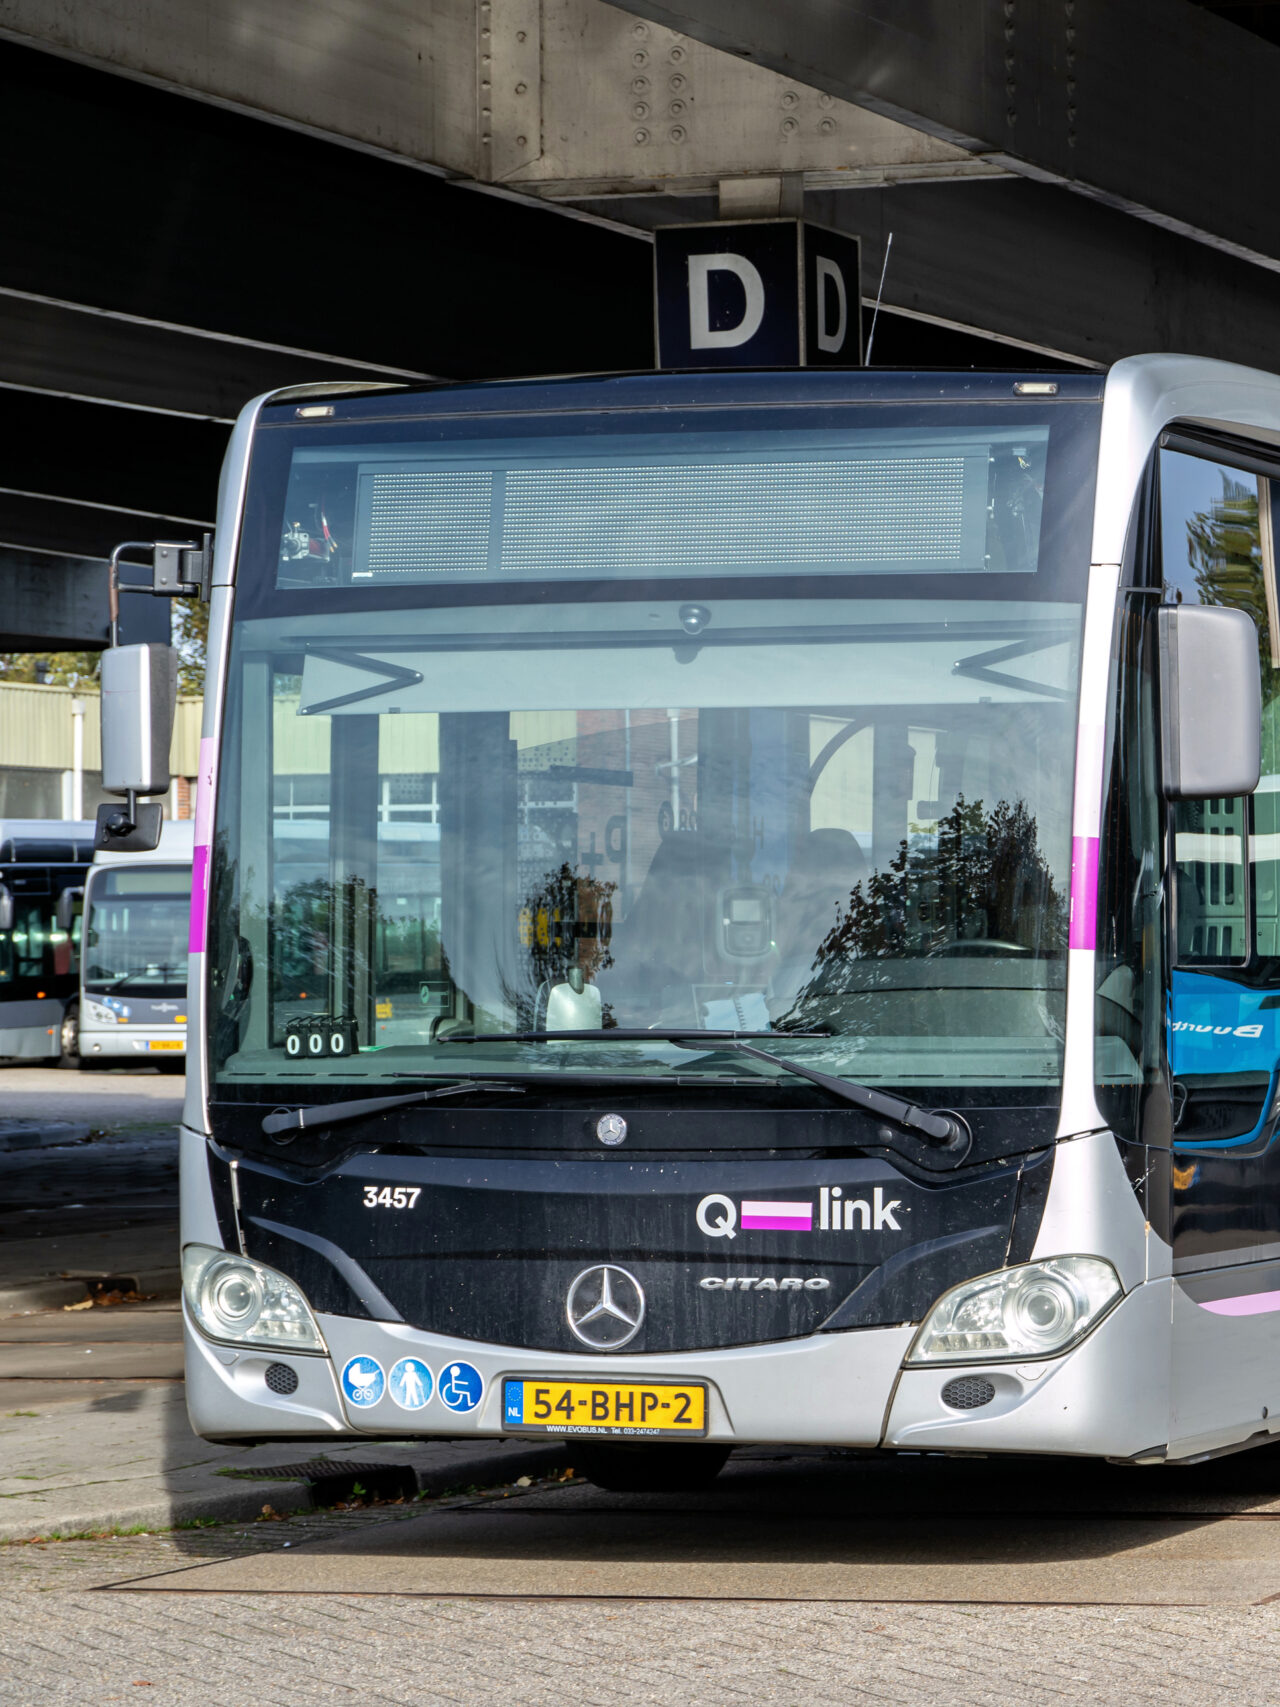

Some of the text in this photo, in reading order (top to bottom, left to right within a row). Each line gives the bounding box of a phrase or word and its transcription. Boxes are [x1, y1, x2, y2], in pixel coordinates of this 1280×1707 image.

[687, 252, 765, 350] D
[816, 255, 847, 354] D
[363, 1186, 422, 1209] 3457
[695, 1187, 902, 1239] Q link
[699, 1277, 831, 1291] CITARO
[507, 1407, 521, 1417] NL
[533, 1388, 693, 1424] 54-BHP-2
[546, 1424, 607, 1434] WWW.EVOBUS.NL
